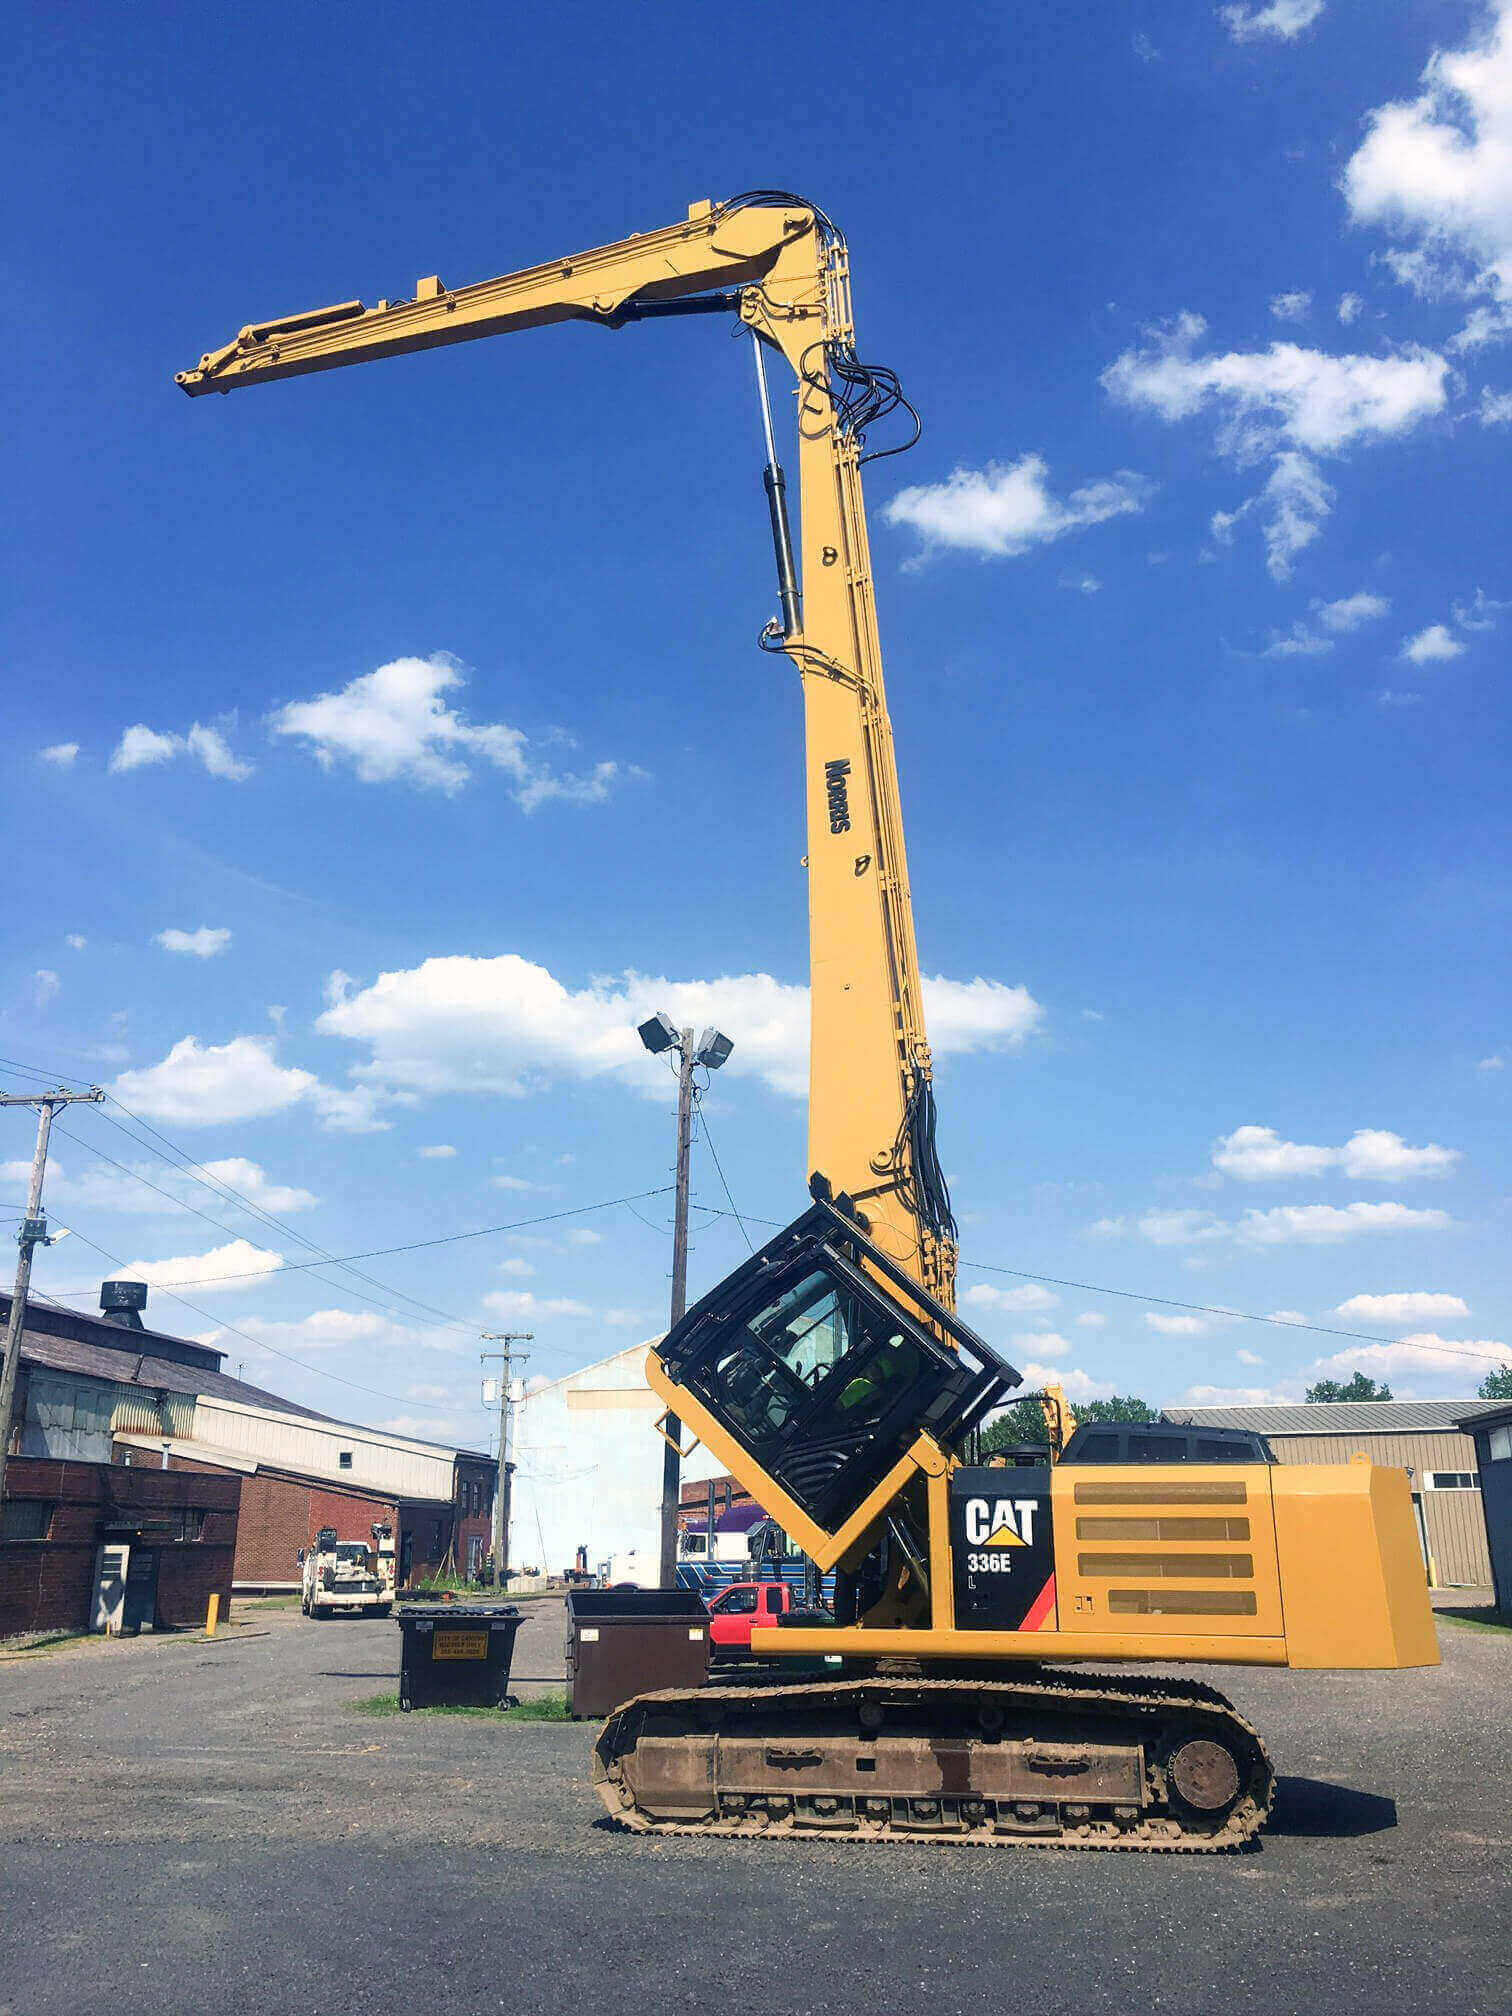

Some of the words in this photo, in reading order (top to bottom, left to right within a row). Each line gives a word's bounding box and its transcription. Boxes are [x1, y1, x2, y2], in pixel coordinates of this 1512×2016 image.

[825, 759, 851, 833] NORRIS
[966, 1498, 1038, 1546] CAT
[967, 1553, 1012, 1573] 336E
